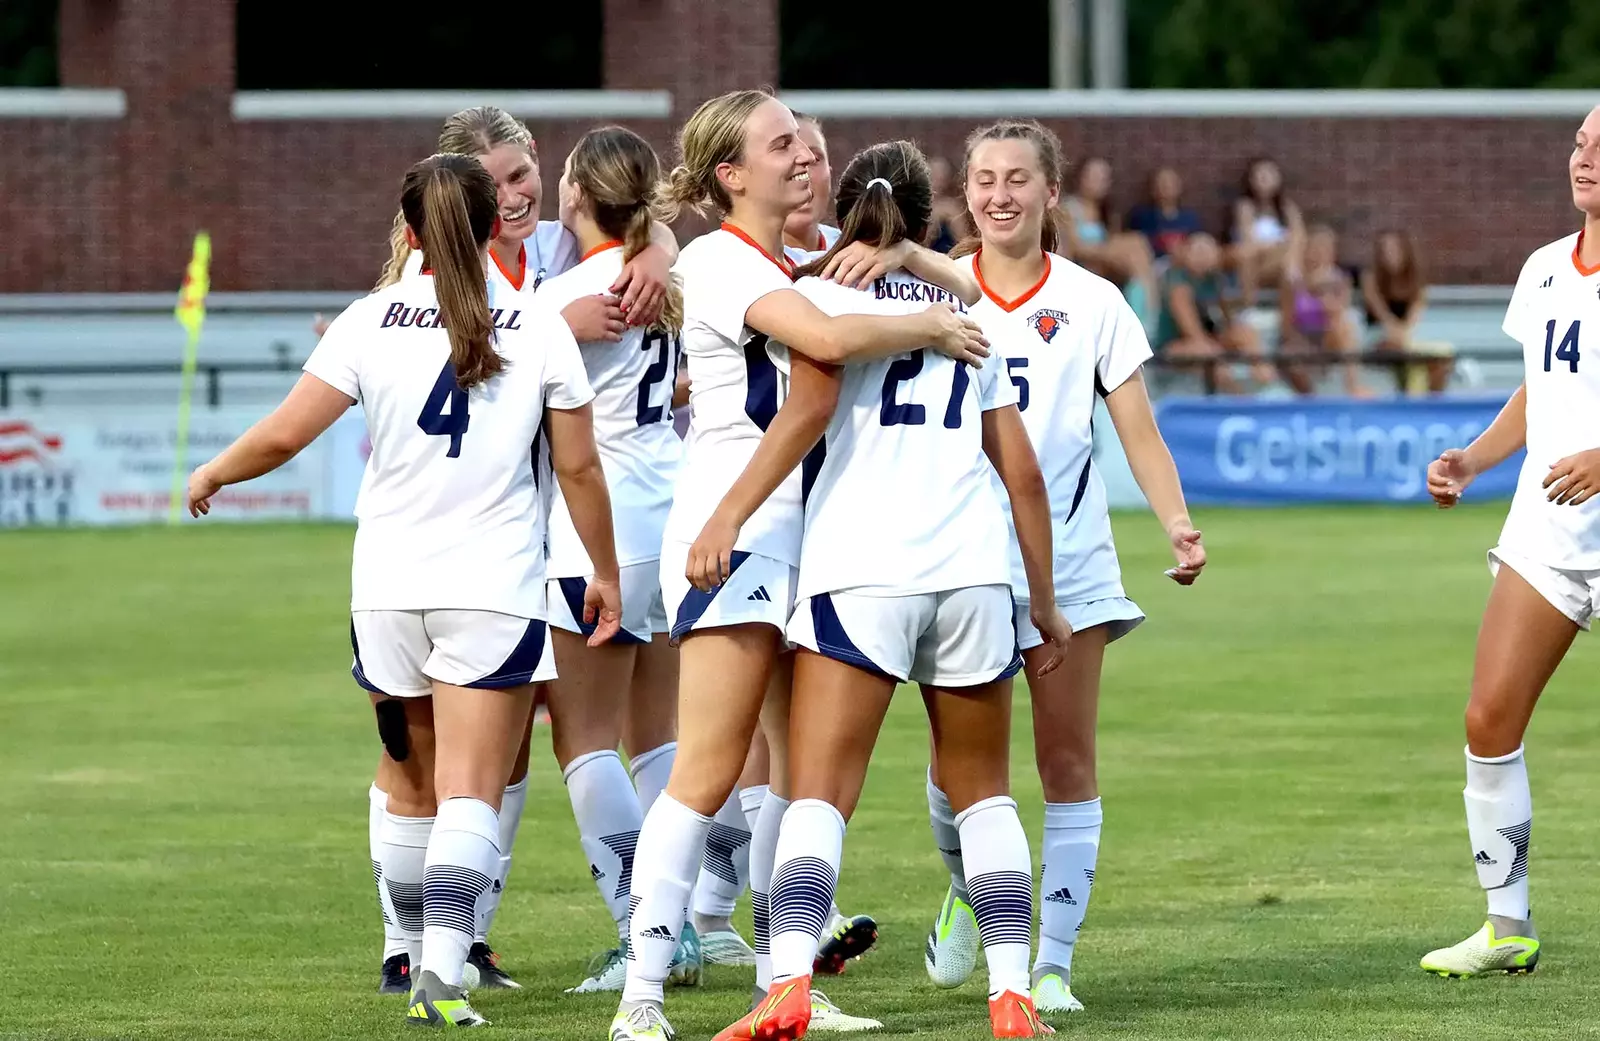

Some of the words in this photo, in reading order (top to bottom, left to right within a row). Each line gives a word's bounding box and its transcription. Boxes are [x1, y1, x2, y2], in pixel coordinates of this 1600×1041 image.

[1544, 319, 1581, 373] 14
[417, 353, 471, 458] 4
[640, 930, 676, 942] adidas
